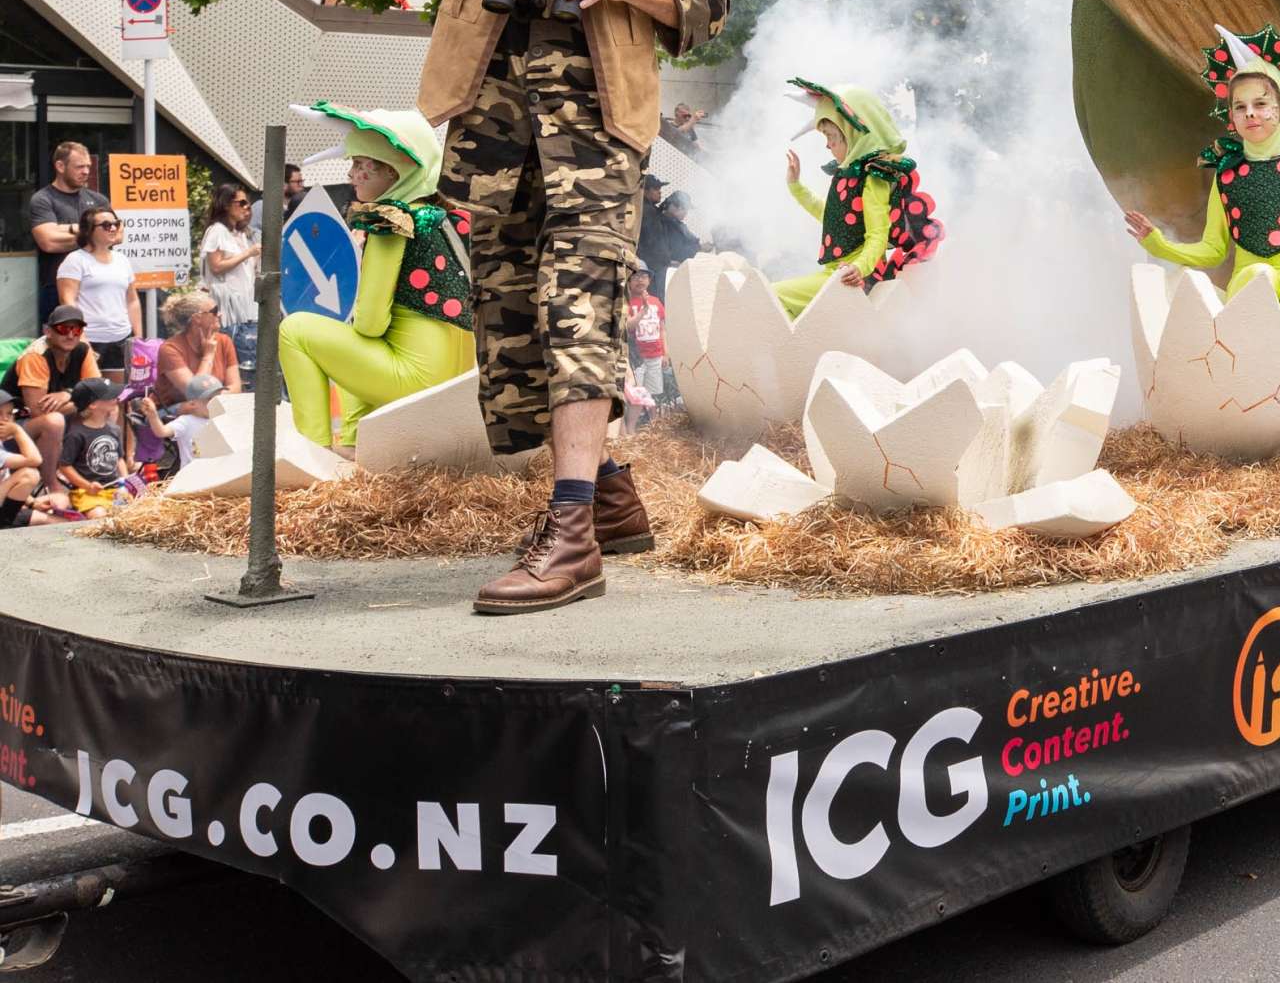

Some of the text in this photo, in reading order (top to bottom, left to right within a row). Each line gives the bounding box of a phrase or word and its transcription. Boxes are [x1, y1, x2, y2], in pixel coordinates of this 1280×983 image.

[119, 163, 180, 183] Special
[125, 185, 176, 202] Event
[137, 217, 185, 228] STOPPING
[127, 233, 150, 243] 5AM
[158, 232, 179, 242] 5PM
[140, 248, 166, 258] 24TH
[167, 247, 188, 257] NOV
[1007, 669, 1141, 728] Creative.
[1002, 712, 1130, 777] Content.
[766, 707, 989, 906] ICG
[1003, 774, 1091, 827] Print.
